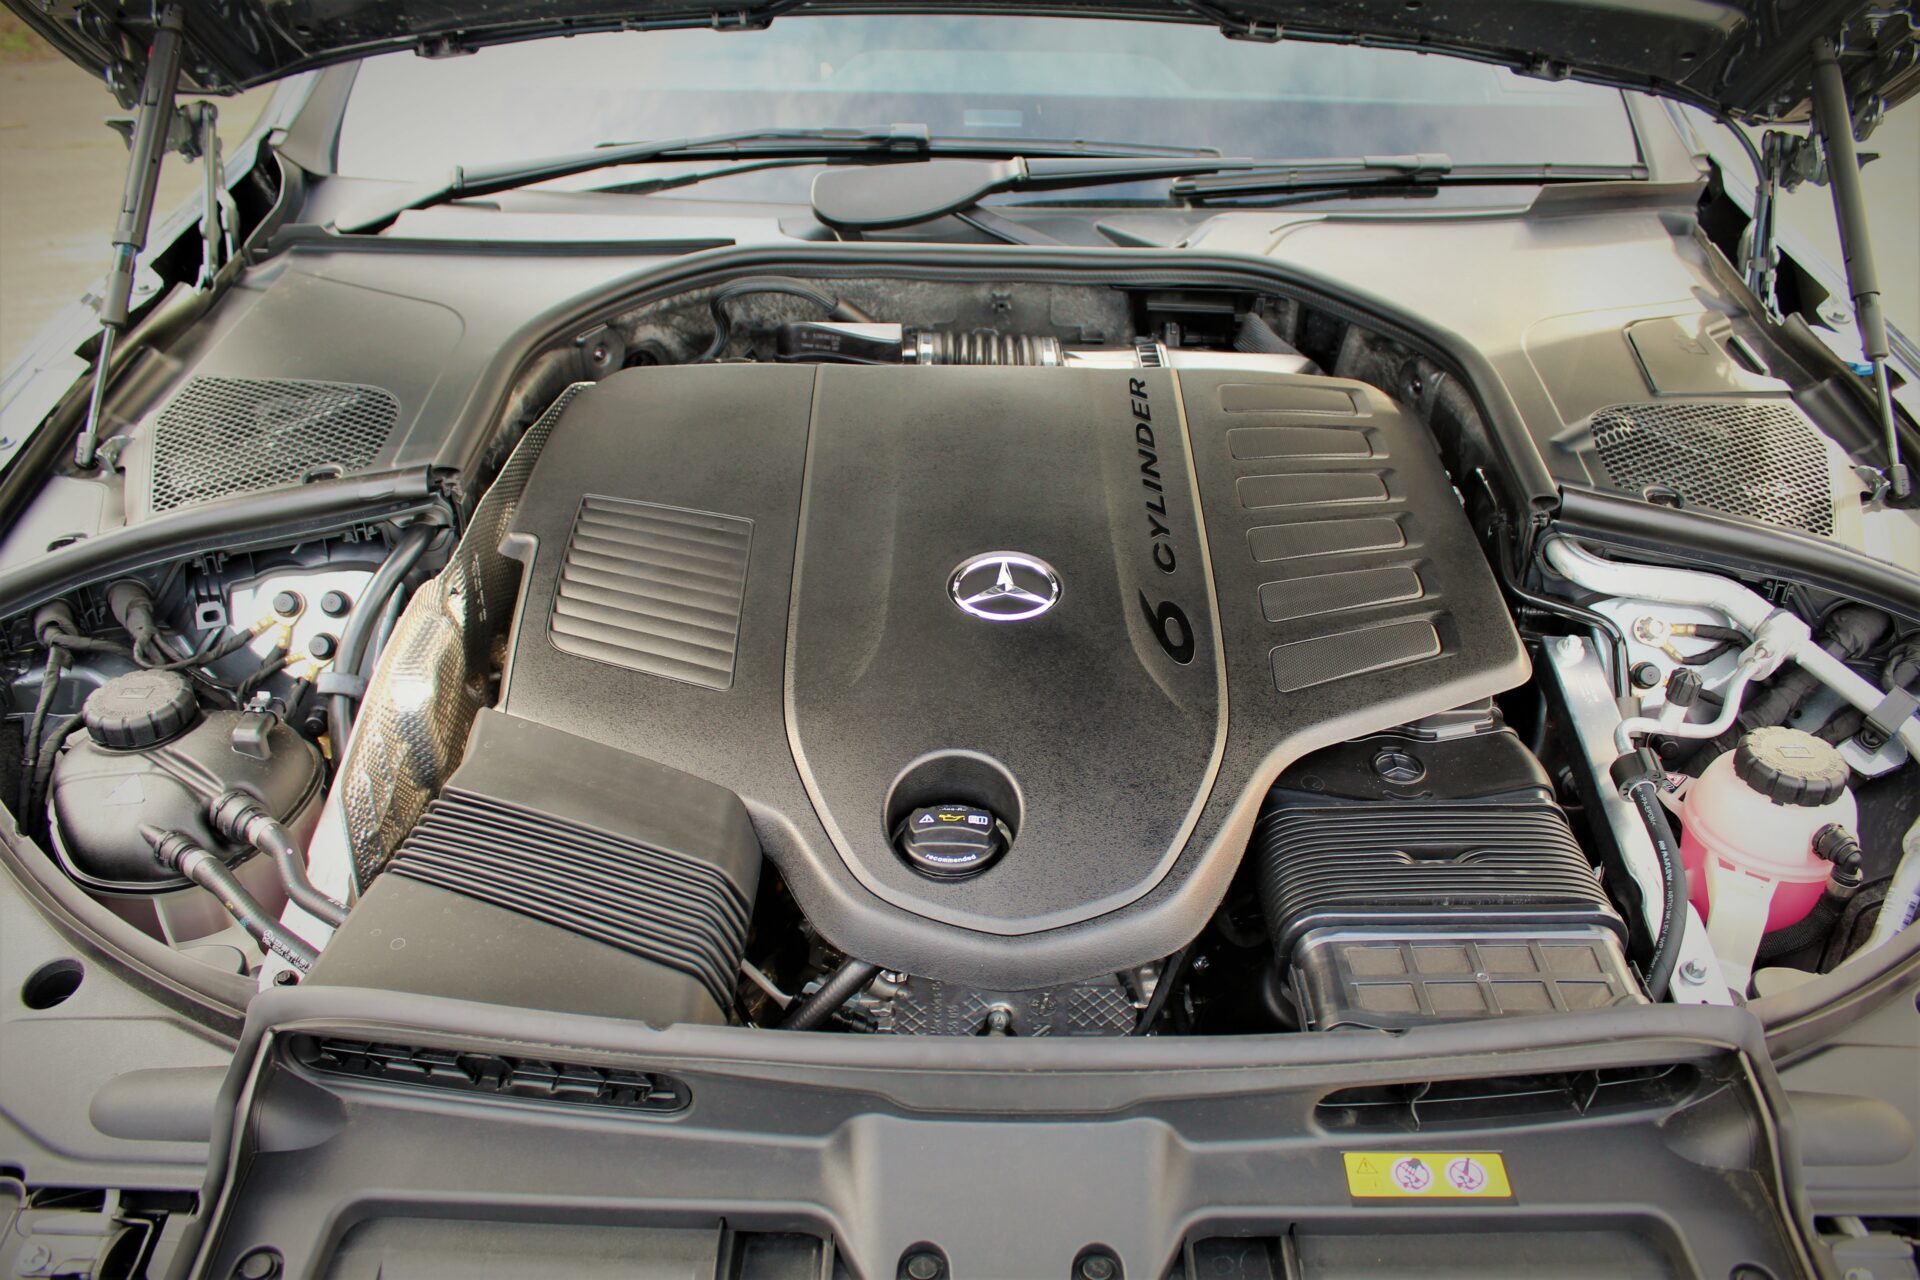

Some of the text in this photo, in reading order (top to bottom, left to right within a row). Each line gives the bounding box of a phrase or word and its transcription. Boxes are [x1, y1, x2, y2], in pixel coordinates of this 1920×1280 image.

[1128, 377, 1196, 666] 6 CYLINDER
[925, 853, 977, 863] recommended
